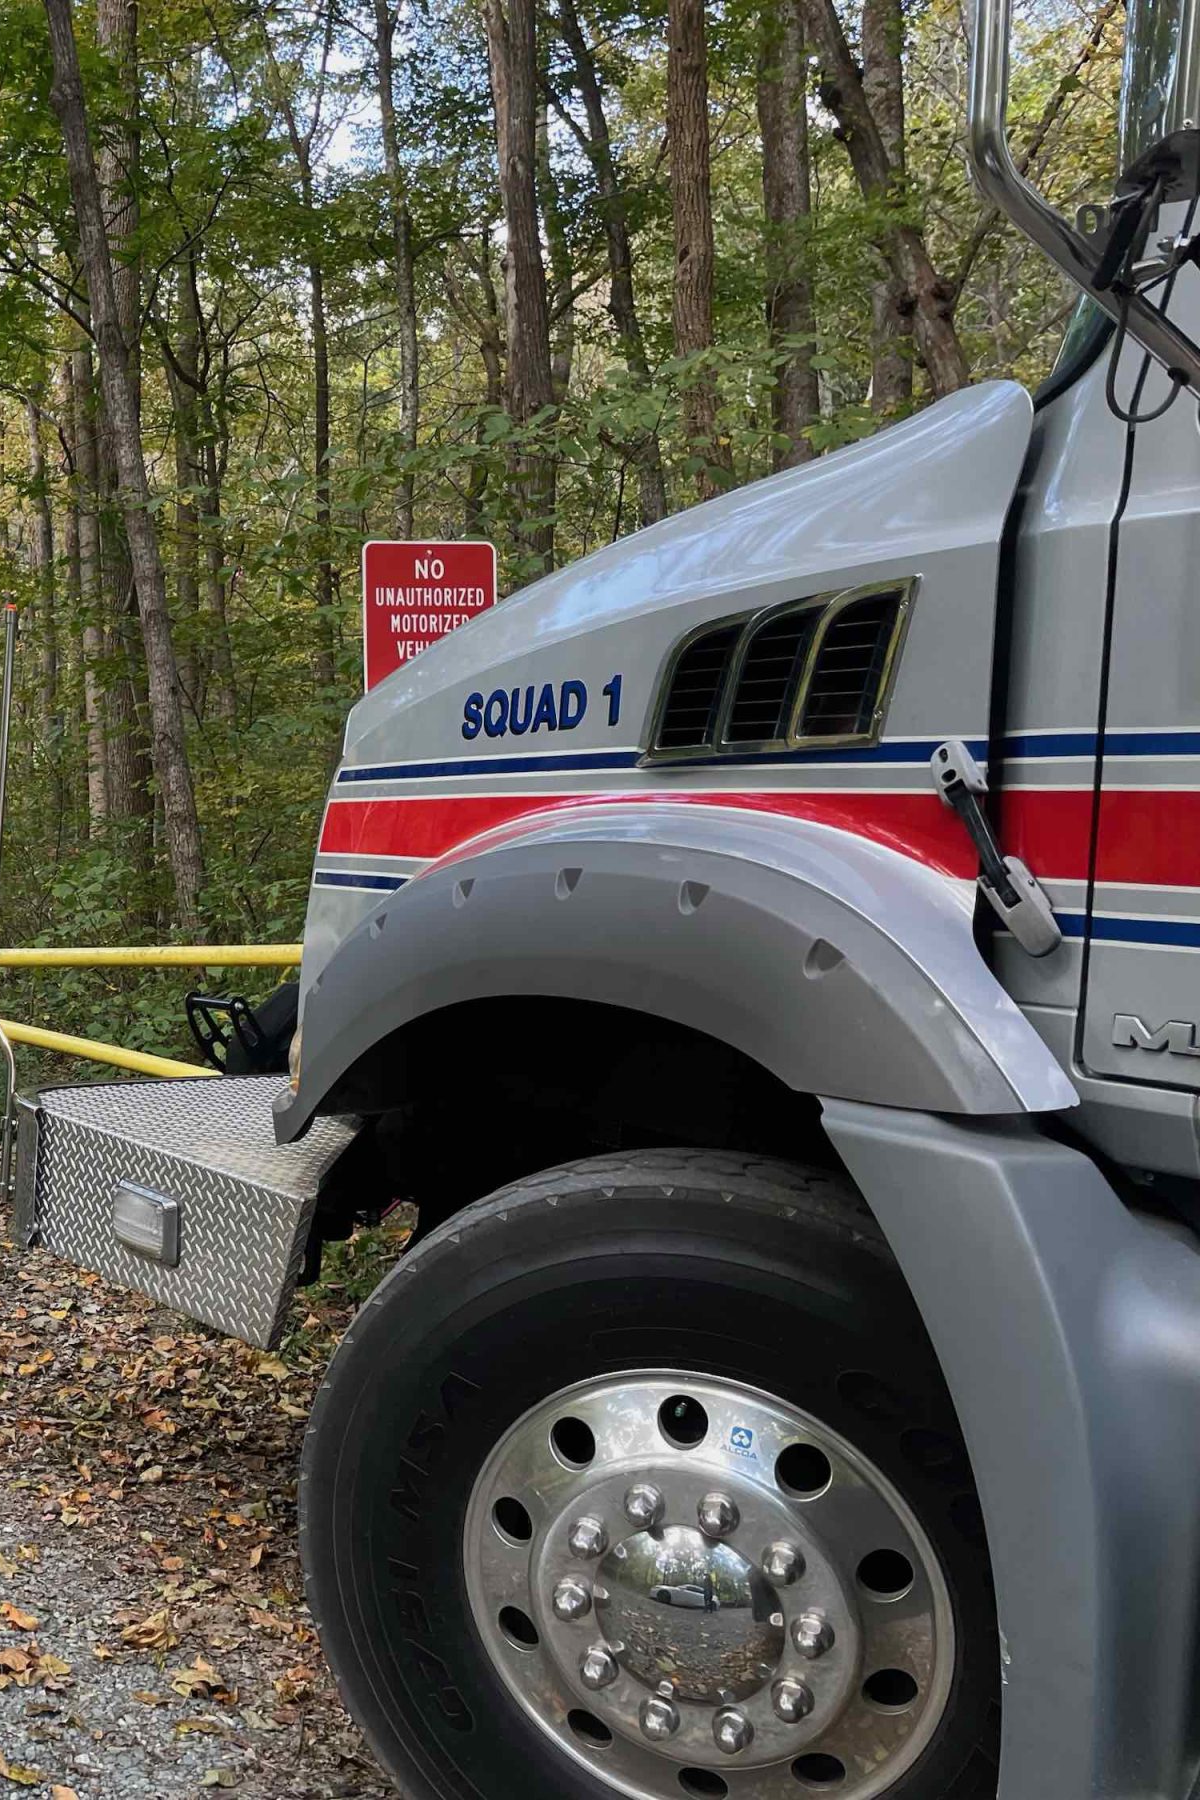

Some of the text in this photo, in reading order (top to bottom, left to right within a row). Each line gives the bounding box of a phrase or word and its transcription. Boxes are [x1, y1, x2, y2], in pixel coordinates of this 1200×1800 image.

[414, 558, 445, 580] NO
[375, 587, 485, 607] UNAUTHORIZED
[461, 674, 623, 741] SQUAD 1
[719, 1443, 757, 1460] ALCOA
